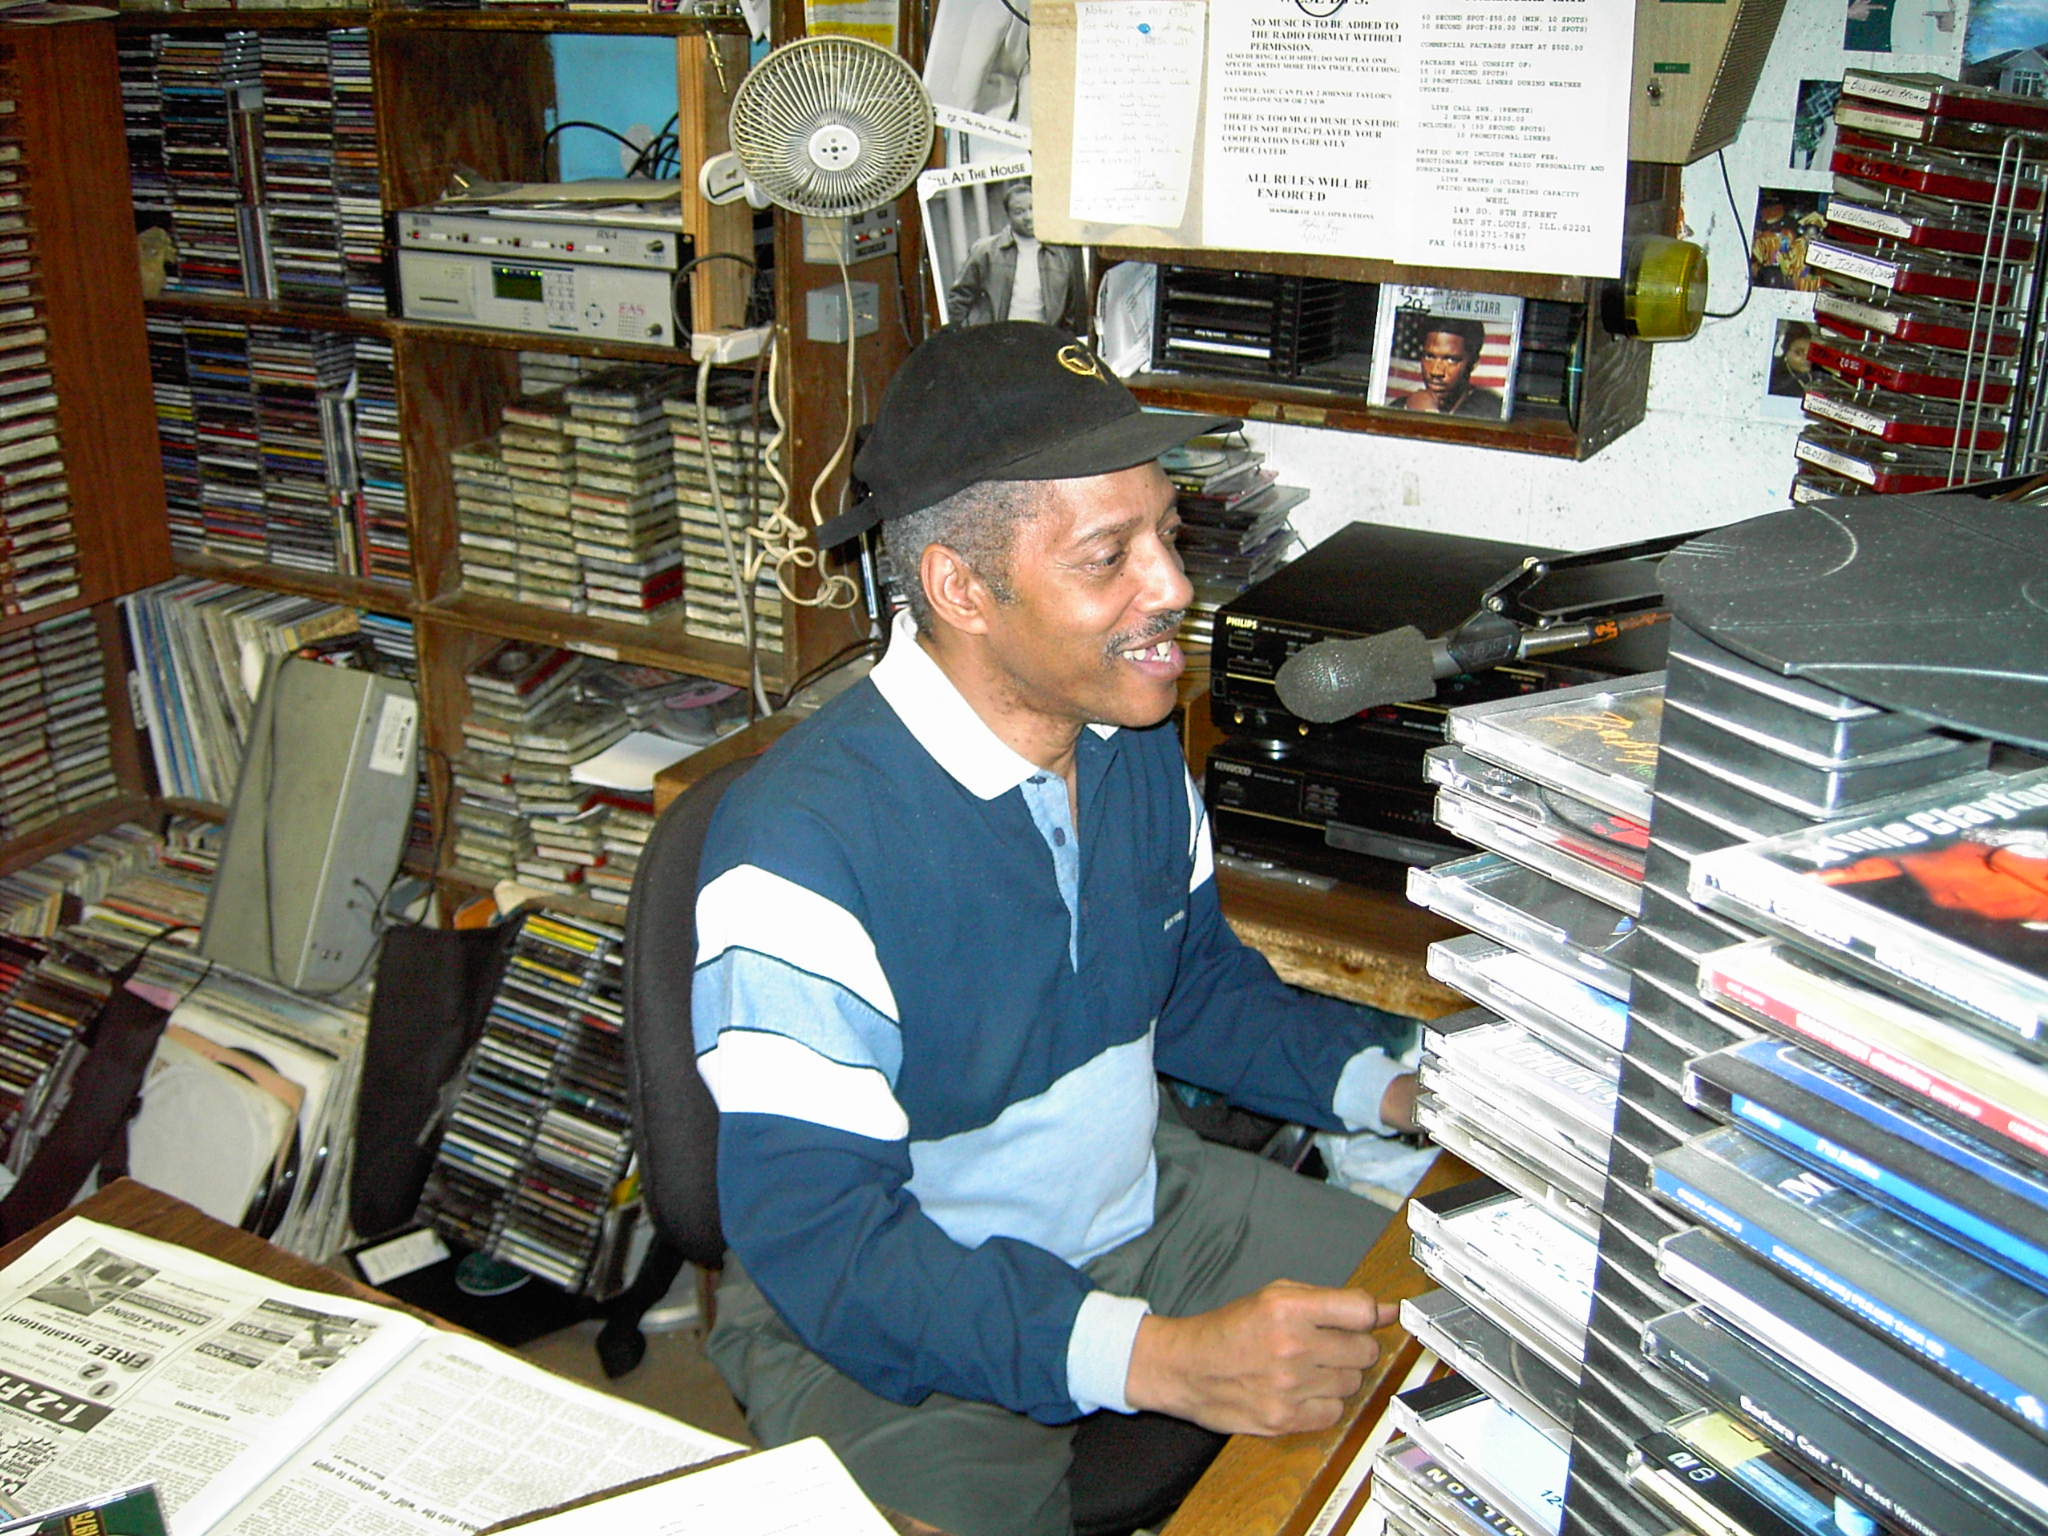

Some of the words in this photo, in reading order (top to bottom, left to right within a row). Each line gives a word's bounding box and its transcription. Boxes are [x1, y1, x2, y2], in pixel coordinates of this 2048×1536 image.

[1251, 18, 1265, 26] NO
[1269, 18, 1299, 27] MUSIC
[1302, 19, 1311, 28] IS
[1315, 20, 1328, 28] TO
[1331, 20, 1343, 29] BE
[1347, 21, 1381, 30] ADDED
[1385, 22, 1398, 30] TO
[1251, 30, 1270, 39] THE
[1273, 31, 1304, 40] RADIO
[1307, 32, 1350, 41] FORMAT
[1353, 33, 1401, 42] WITHOUT
[1224, 112, 1252, 121] THERE
[1256, 114, 1264, 122] IS
[1268, 114, 1286, 123] TOO
[1289, 115, 1318, 124] MUCH
[1320, 117, 1349, 126] MUSIC
[1352, 118, 1362, 126] IN
[1224, 123, 1247, 132] THAT
[1250, 125, 1258, 133] IS
[1261, 125, 1279, 134] NOT
[1282, 126, 1310, 135] BEING
[1355, 129, 1382, 138] YOUR
[1222, 135, 1289, 145] COOPERATION
[1292, 138, 1300, 146] IS
[1302, 138, 1347, 147] GREATLY
[968, 168, 986, 181] THE
[990, 163, 1025, 178] HOUSE
[1536, 163, 1585, 171] PERSONALITY
[1246, 174, 1269, 184] ALL
[1274, 175, 1314, 186] RULES
[1319, 177, 1351, 188] WILL
[1355, 179, 1371, 189] BE
[1258, 188, 1326, 201] ENFORCED
[1486, 197, 1509, 205] WESL
[1328, 211, 1374, 220] OPERATIONS
[1454, 207, 1469, 215] 149
[1500, 209, 1516, 217] 8TH
[1523, 210, 1558, 219] STREET
[1453, 218, 1474, 226] EAST
[1429, 239, 1445, 247] FAX
[1445, 297, 1471, 312] EDWIN
[1474, 301, 1501, 315] STARR
[1226, 616, 1258, 630] PHILIPS
[1214, 761, 1252, 776] KENWOOD
[3, 1313, 91, 1347] Installation!
[88, 1343, 150, 1369] FREE
[82, 1364, 104, 1378] 2
[95, 1384, 111, 1396] 1
[1740, 1394, 1797, 1443] Barbara
[1796, 1434, 1829, 1464] Carr
[1840, 1465, 1863, 1490] The
[1863, 1482, 1893, 1510] Best
[336, 1470, 347, 1480] to
[347, 1475, 377, 1491] others
